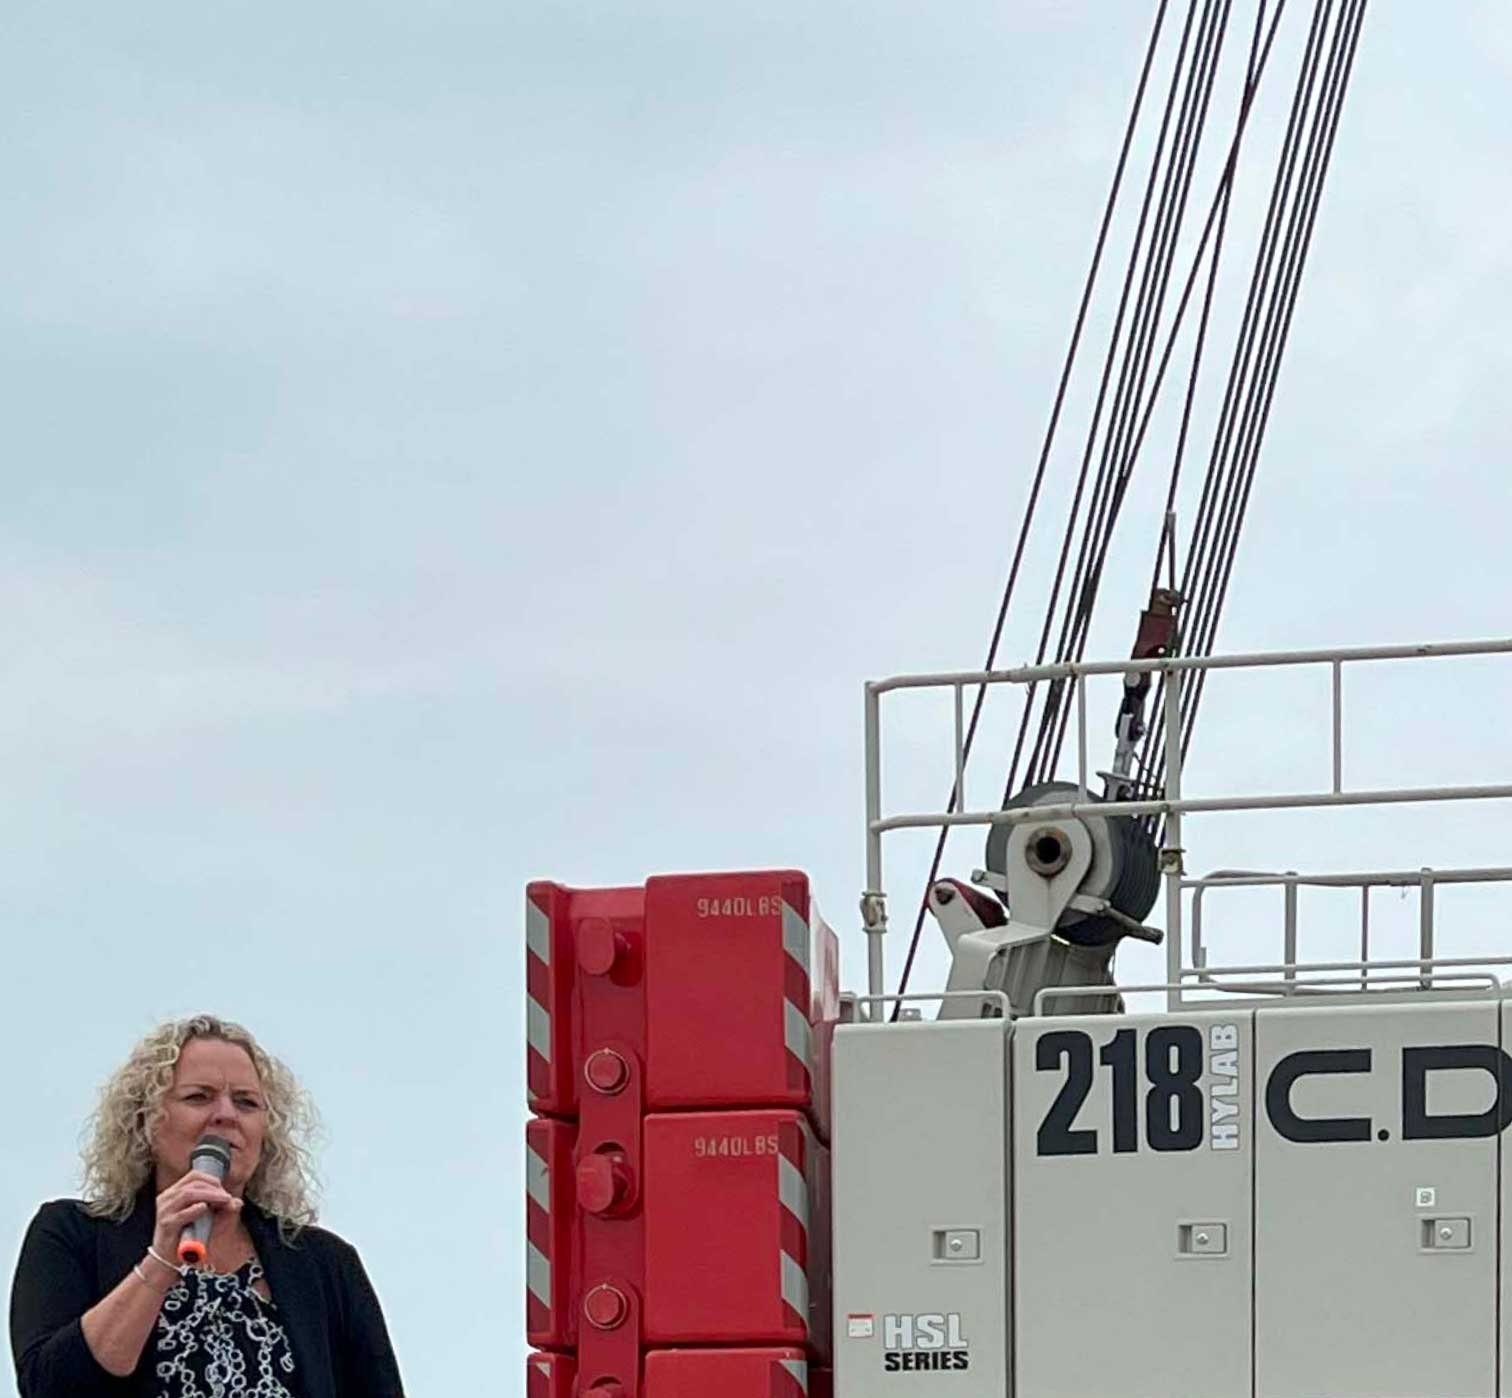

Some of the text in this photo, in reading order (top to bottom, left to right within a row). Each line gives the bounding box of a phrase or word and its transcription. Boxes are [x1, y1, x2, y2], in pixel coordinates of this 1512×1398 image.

[697, 895, 782, 918] 9440LBS
[1036, 1025, 1203, 1156] 218
[1210, 1023, 1239, 1150] HYLAB
[694, 1135, 778, 1157] 9440LBS
[884, 1313, 968, 1349] HSL
[884, 1351, 969, 1372] SERIES
